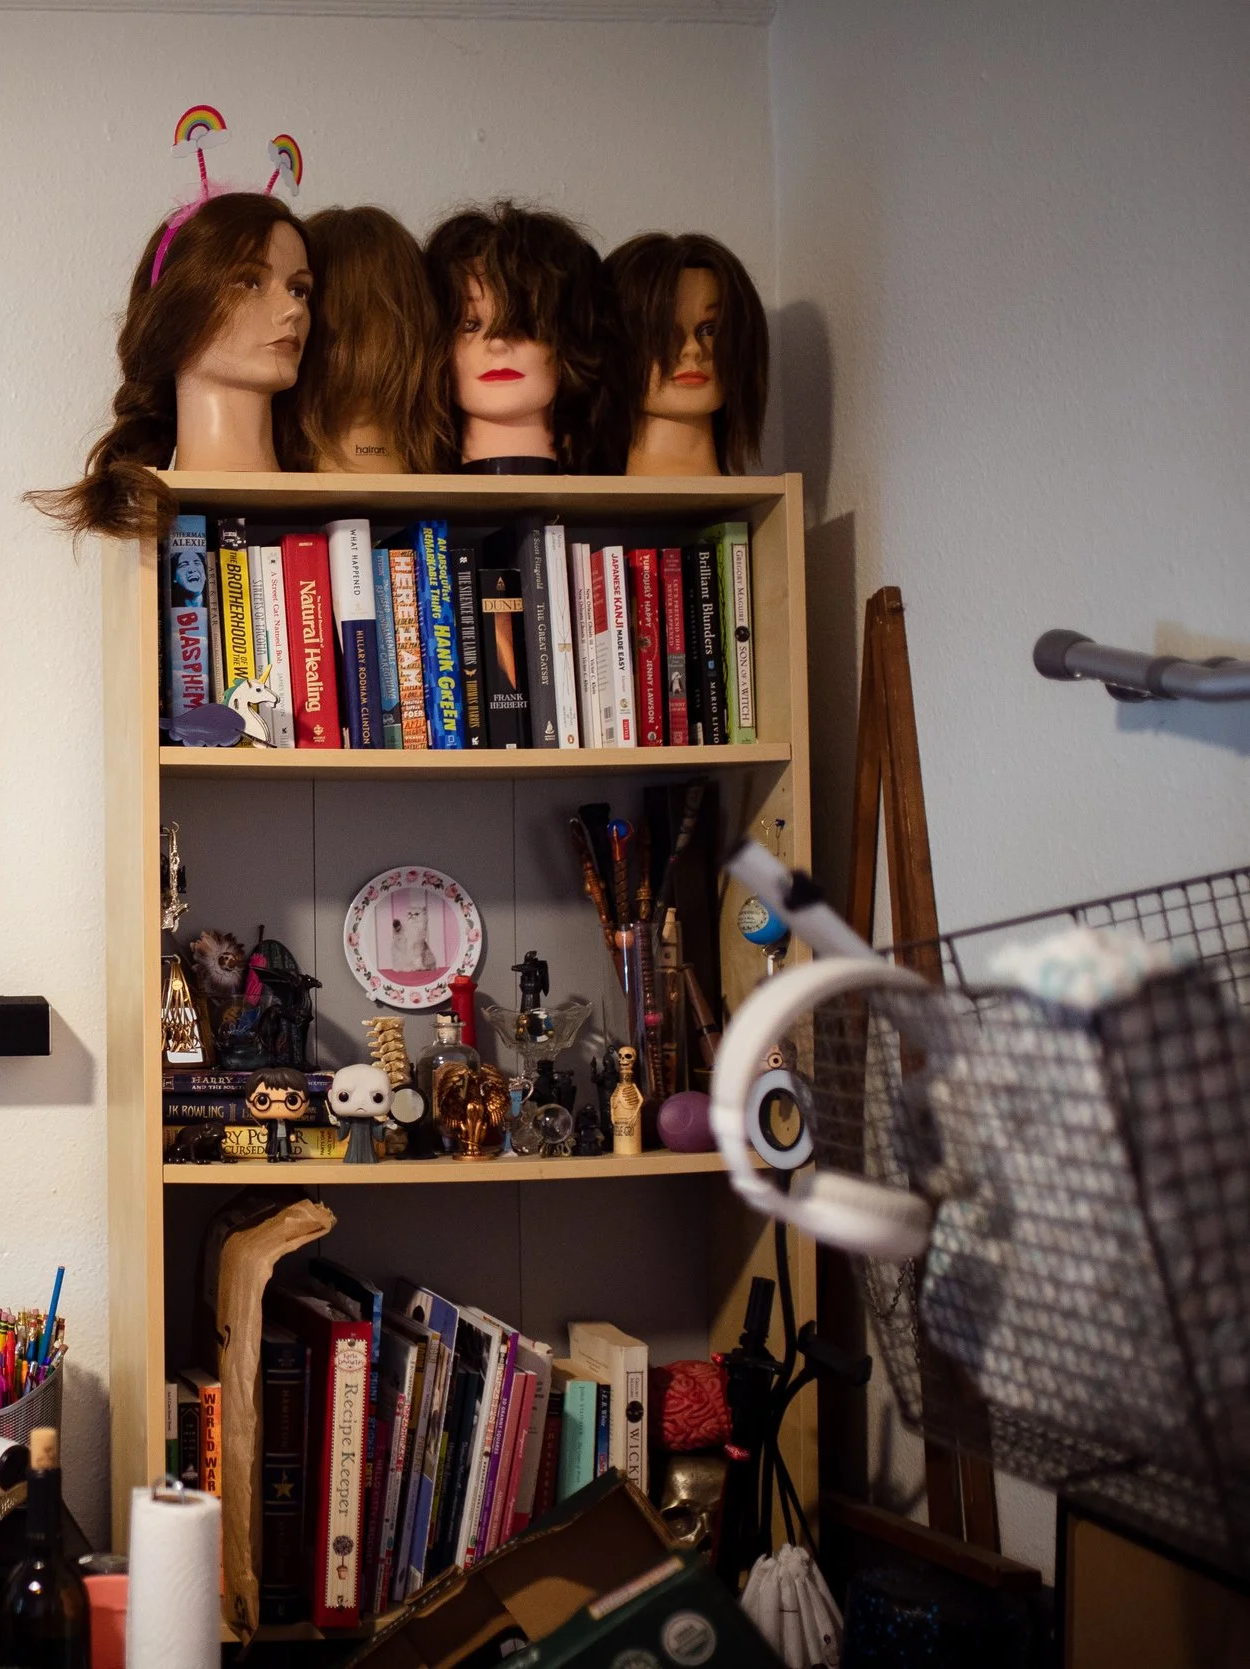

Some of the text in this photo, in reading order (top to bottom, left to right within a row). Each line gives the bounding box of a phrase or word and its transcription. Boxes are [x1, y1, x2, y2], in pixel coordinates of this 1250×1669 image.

[172, 539, 206, 547] ALEXIE
[533, 537, 541, 556] Scott
[350, 528, 361, 597] WHAT HAPPENED
[422, 527, 442, 619] REMARKABLE THING
[437, 537, 451, 603] AN ABSOLUTELY
[534, 557, 544, 590] Fitzgerald
[208, 567, 216, 587] ART
[271, 579, 279, 602] Street
[394, 556, 416, 619] HERE
[458, 571, 471, 584] THE
[735, 550, 745, 622] GREGORY MAGUIRE
[252, 580, 264, 609] STREETS
[459, 584, 474, 615] SILENCE
[484, 599, 522, 611] DUNE
[699, 551, 716, 655] Brilliant Blunders
[210, 601, 219, 626] FEAR
[226, 564, 247, 654] BROTHERHOOD
[254, 611, 266, 622] OF
[272, 604, 280, 617] Cat
[299, 580, 320, 644] Natural
[611, 553, 626, 671] JAPANESE KANJI MADE EASY
[643, 600, 653, 628] HAPPY
[255, 624, 266, 656] TACOMA
[274, 620, 282, 647] Named
[398, 627, 417, 644] I
[462, 626, 476, 640] THE
[536, 603, 549, 686] THE GREAT GATSBY
[177, 612, 205, 710] BLASPHEM
[233, 654, 241, 666] THE
[241, 655, 248, 666] OF
[275, 649, 283, 664] Bob
[463, 641, 477, 665] LAMBS
[739, 645, 748, 668] SON
[304, 648, 324, 713] Healing
[398, 649, 422, 686] AM
[434, 624, 458, 731] HANK GREEN
[356, 630, 371, 745] HILLARY RODHAM CLINTON
[466, 680, 478, 704] THOMAS
[493, 693, 523, 701] FRANK
[404, 710, 423, 719] FOER
[490, 701, 528, 709] HERBERT
[647, 688, 655, 724] LAWSON
[710, 681, 720, 744] MARIO LIVIO
[741, 686, 750, 721] WITCH
[191, 1076, 234, 1084] HARRY
[166, 1105, 225, 1118] JK ROWLING
[224, 1146, 265, 1155] CURSED
[339, 1383, 359, 1447] Recipe
[498, 1406, 507, 1429] GRANNY
[203, 1393, 217, 1491] WORLD WAR
[494, 1429, 503, 1455] SQUARES
[336, 1451, 356, 1518] Keeper
